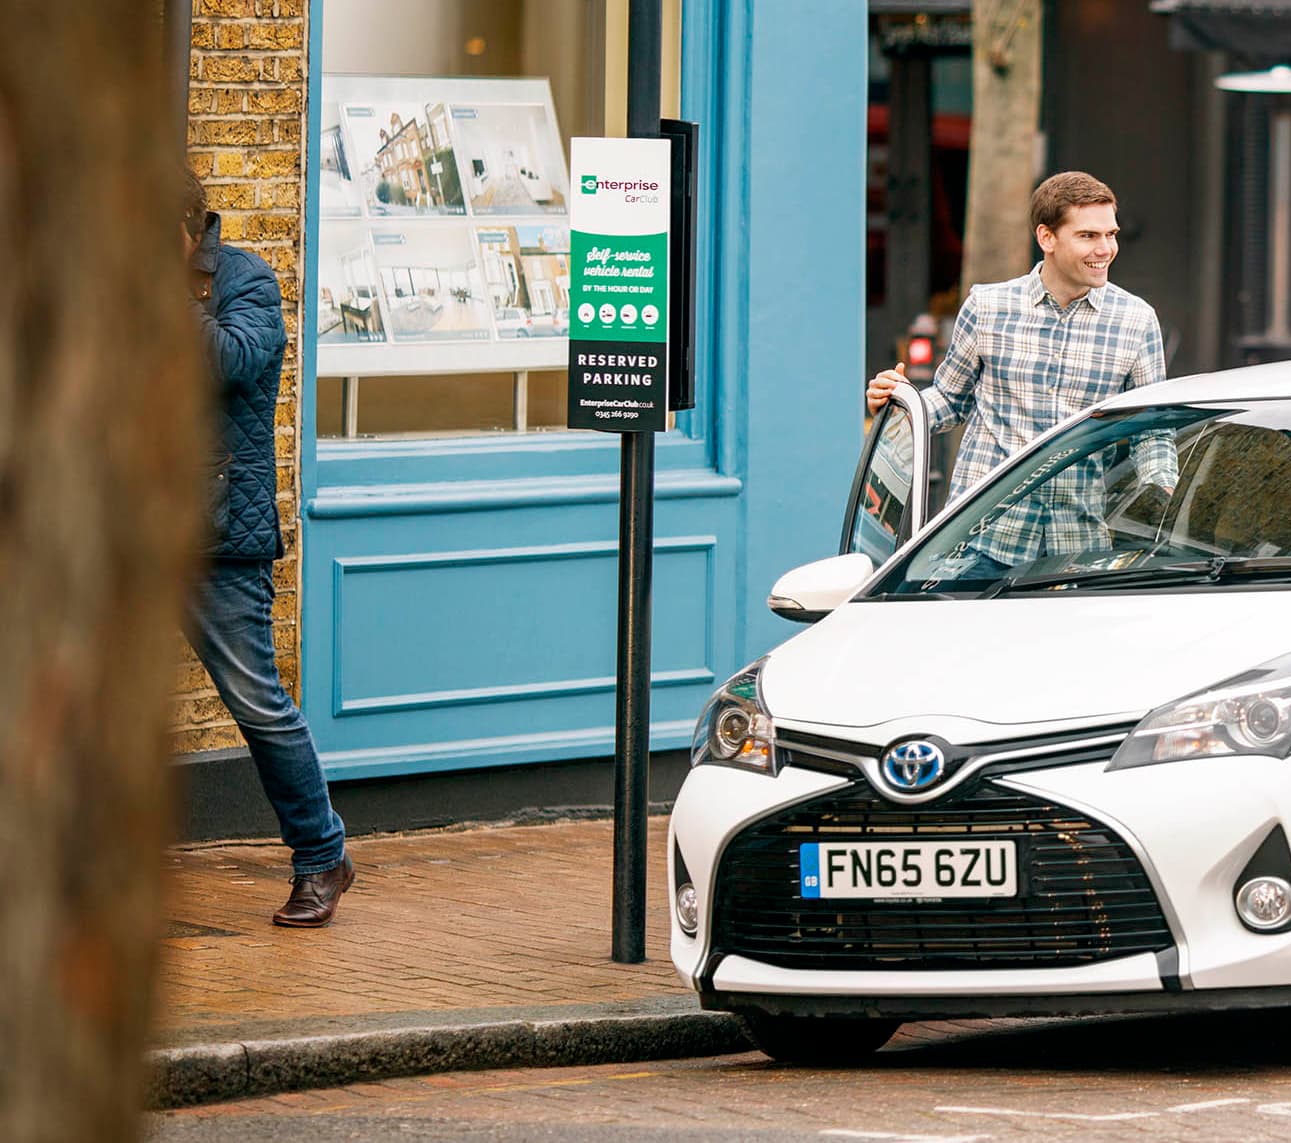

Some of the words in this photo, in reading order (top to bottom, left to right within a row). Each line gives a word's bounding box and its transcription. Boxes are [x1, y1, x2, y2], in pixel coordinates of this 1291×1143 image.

[581, 178, 659, 193] enterprise
[624, 194, 659, 204] CarClub
[586, 246, 652, 265] Self-service
[583, 265, 620, 277] vehicle
[621, 265, 655, 278] rental
[582, 284, 593, 292] BY
[594, 284, 607, 292] THE
[608, 285, 628, 293] HOUR
[628, 286, 639, 294] OR
[639, 286, 654, 294] DAY
[577, 354, 658, 367] RESERVED
[583, 372, 652, 386] PARKING
[594, 411, 610, 419] 0345
[611, 410, 622, 418] 266
[623, 411, 639, 419] 9290
[827, 848, 922, 888] FN65
[935, 847, 1007, 888] 6ZU
[804, 876, 818, 887] GB
